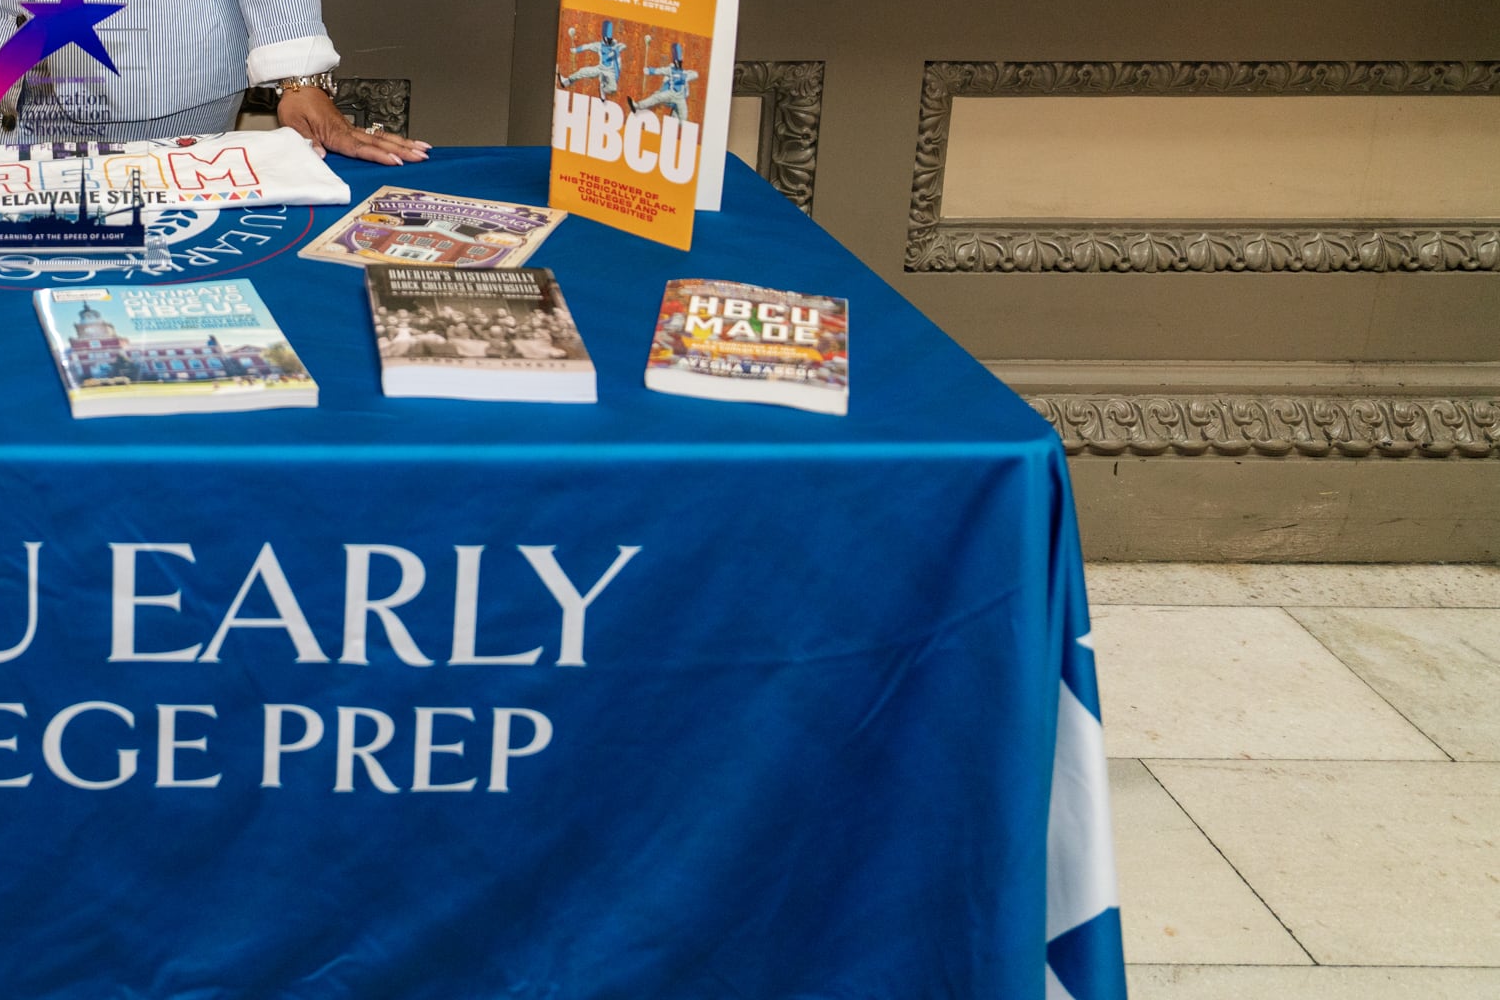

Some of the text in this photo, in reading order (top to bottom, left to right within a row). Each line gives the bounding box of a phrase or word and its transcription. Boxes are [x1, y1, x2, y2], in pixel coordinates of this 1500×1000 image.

[19, 106, 110, 121] Innovation
[23, 120, 106, 137] Showcase
[552, 89, 699, 185] HBCU
[107, 190, 167, 205] STATE
[559, 174, 676, 214] HISTORICALLY BLACK
[580, 171, 659, 200] THE POWER OF
[578, 186, 658, 216] COLLEGES AND
[581, 194, 654, 223] UNIVERSITIES
[379, 202, 534, 229] HISTORICALLY BLACK
[64, 233, 88, 241] SPEED
[388, 269, 536, 283] AMERICA'S HISTORICALLY
[124, 293, 244, 307] GUIDE TO
[126, 285, 237, 299] ULTIMATE
[688, 295, 819, 326] HBCU
[684, 316, 819, 346] MADE
[678, 357, 744, 373] AYESHA
[750, 364, 818, 379] RASCOE
[106, 541, 644, 668] EARLY
[262, 702, 553, 794] PREP
